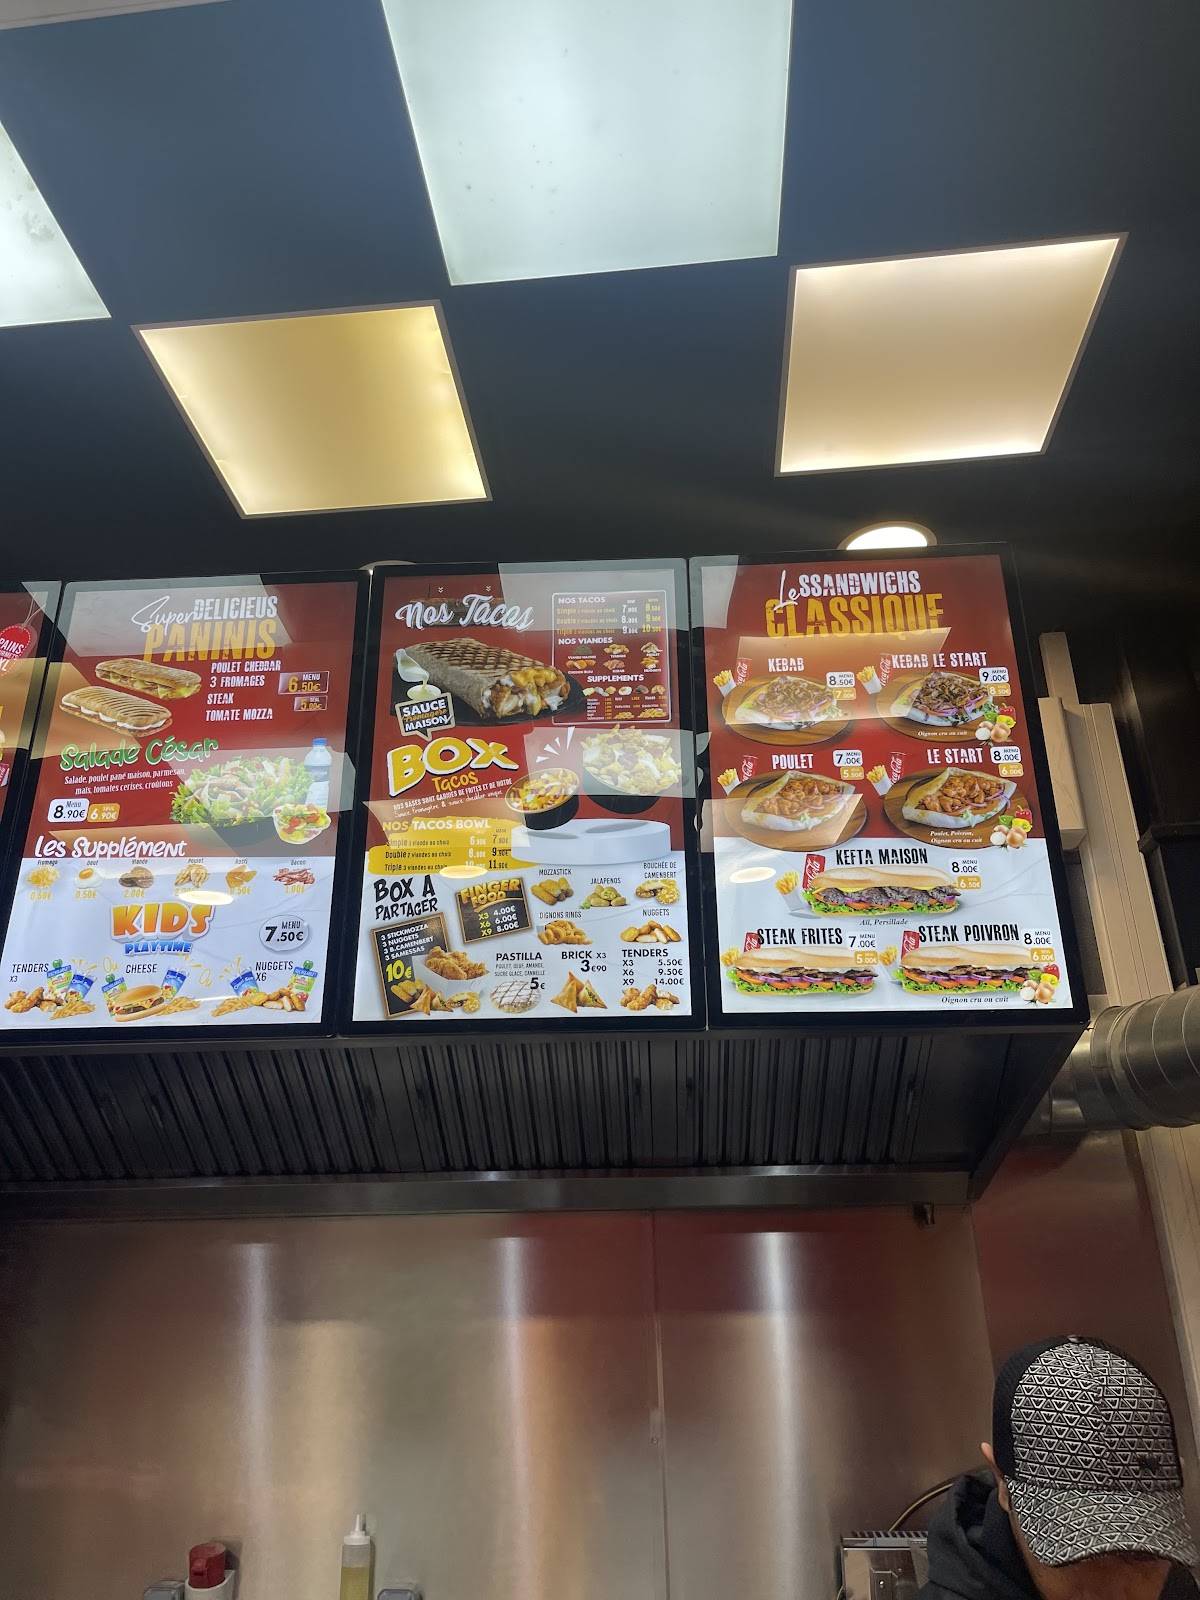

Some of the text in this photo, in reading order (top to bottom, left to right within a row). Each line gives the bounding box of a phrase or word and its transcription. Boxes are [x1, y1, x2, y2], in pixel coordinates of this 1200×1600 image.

[193, 595, 278, 620] DELICIEUS
[395, 594, 534, 631] Nos Tacos
[765, 593, 944, 640] CLASSIQUE
[143, 619, 277, 662] PANINIS
[211, 660, 281, 673] POULET CHEDDAR
[768, 657, 804, 672] KEBAB
[892, 651, 987, 669] KEBAB LE START
[210, 675, 265, 688] 3 FROMAGES
[587, 674, 644, 683] SUPPLEMENTS
[829, 675, 854, 686] 8.50€
[982, 671, 1008, 682] 9.00€
[207, 693, 234, 704] STEAK
[402, 699, 446, 716] SAUCE
[206, 708, 273, 721] TOMATE MOZZA
[405, 714, 447, 731] MAISON
[59, 735, 219, 772] Salade César
[835, 753, 861, 765] 7.00€
[927, 748, 983, 764] LE START
[993, 750, 1020, 762] 8.00€
[387, 737, 519, 797] BOX
[772, 754, 813, 770] POULET
[53, 805, 86, 819] 8.90€
[383, 819, 491, 831] NOS TACOS BOWL
[35, 835, 187, 860] Les Supplément
[385, 851, 406, 859] Double
[836, 848, 928, 865] KEFTA MAISON
[385, 864, 401, 873] Triple
[669, 861, 677, 869] DE
[951, 861, 978, 873] 8.00€
[373, 875, 436, 902] BOX A
[460, 880, 521, 903] FINGER
[472, 890, 506, 908] FOOD
[375, 898, 438, 921] PARTAGER
[478, 905, 516, 920] X3 4.00€
[539, 911, 582, 919] OIGNONS RINGS
[642, 909, 670, 917] NUGGETS
[112, 902, 215, 940] KIDS
[281, 921, 301, 930] MENU
[479, 913, 517, 929] X6 6.00€
[265, 926, 304, 942] 7.50€
[387, 923, 429, 939] STICKMOZZA
[481, 921, 519, 937] X9 8.00€
[918, 924, 1020, 942] STEAK POIVRON
[388, 933, 419, 947] NUGGETS
[757, 928, 843, 945] STEAK FRITES
[848, 935, 876, 948] 7.00€
[1024, 932, 1051, 945] 8.00€
[124, 942, 192, 955] PLAYTIME
[391, 946, 425, 959] SAMESSAS
[622, 949, 668, 957] TENDERS
[495, 952, 542, 961] PASTILLA
[561, 951, 592, 960] BRICK
[12, 963, 49, 973] TENDERS
[125, 963, 157, 973] CHEESE
[255, 961, 293, 971] NUGGETS
[385, 959, 412, 983] 10€
[255, 973, 267, 981] X6
[941, 996, 968, 1004] Oignon
